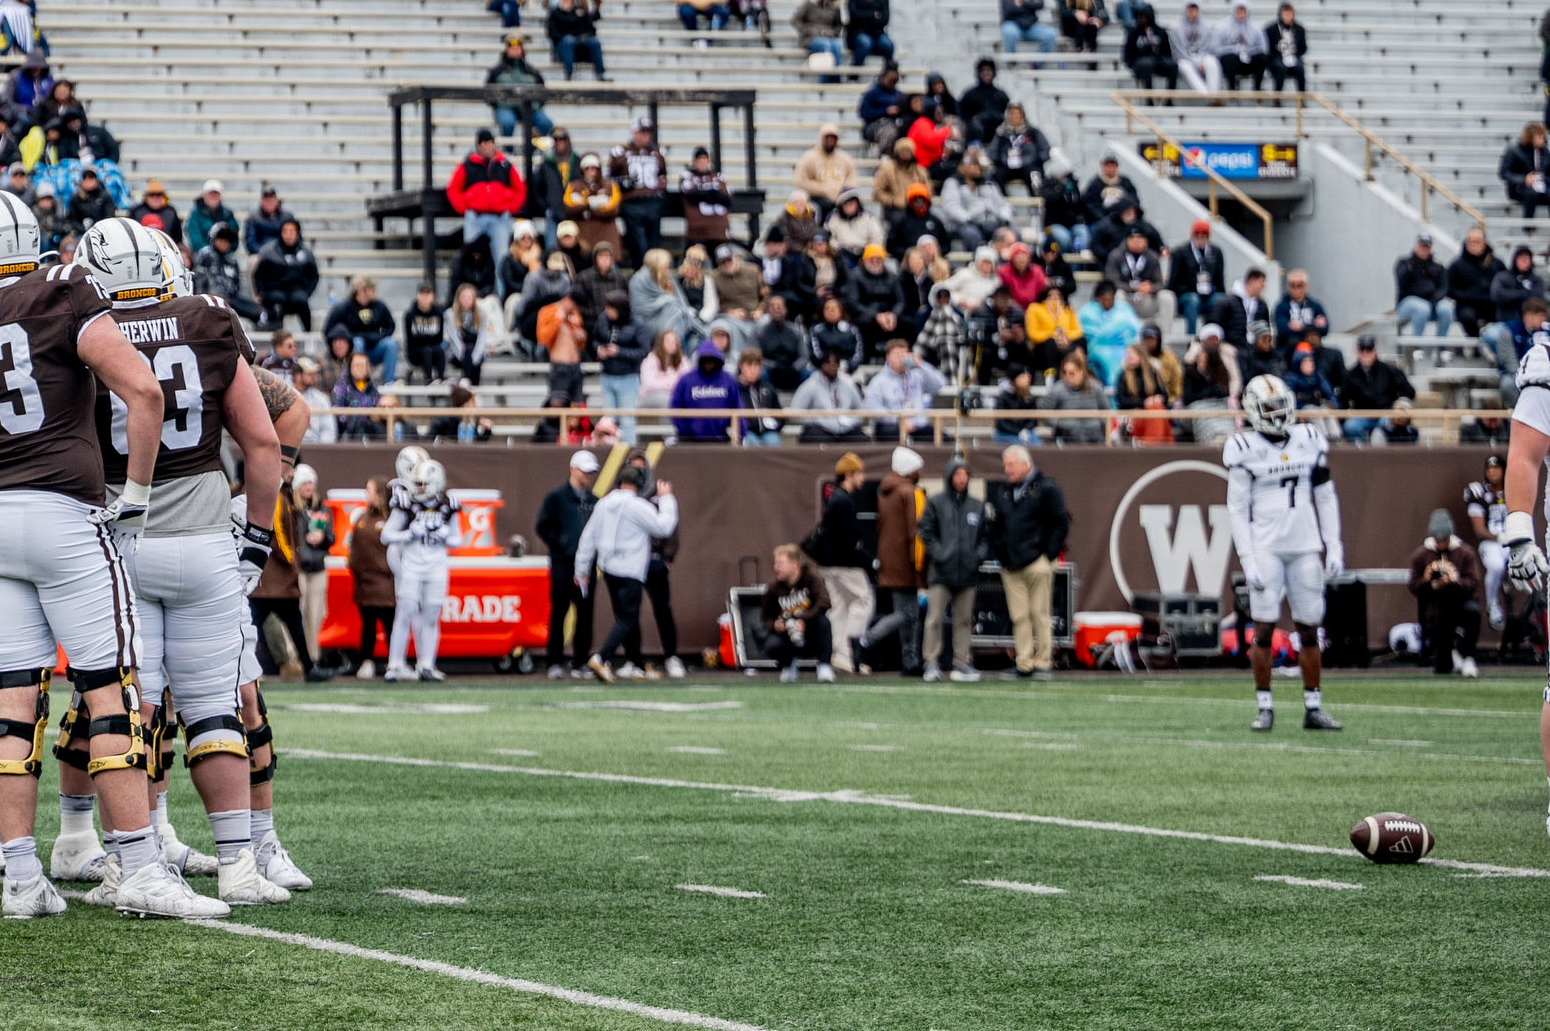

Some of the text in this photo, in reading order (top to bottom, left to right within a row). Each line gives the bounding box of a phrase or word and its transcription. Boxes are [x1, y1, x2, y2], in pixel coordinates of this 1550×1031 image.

[1208, 152, 1254, 170] pepsi
[117, 288, 157, 300] BRONCOS
[117, 317, 179, 343] HERWIN
[1280, 475, 1299, 508] 7
[469, 506, 490, 531] G
[1140, 504, 1232, 597] W
[441, 595, 521, 623] RADE
